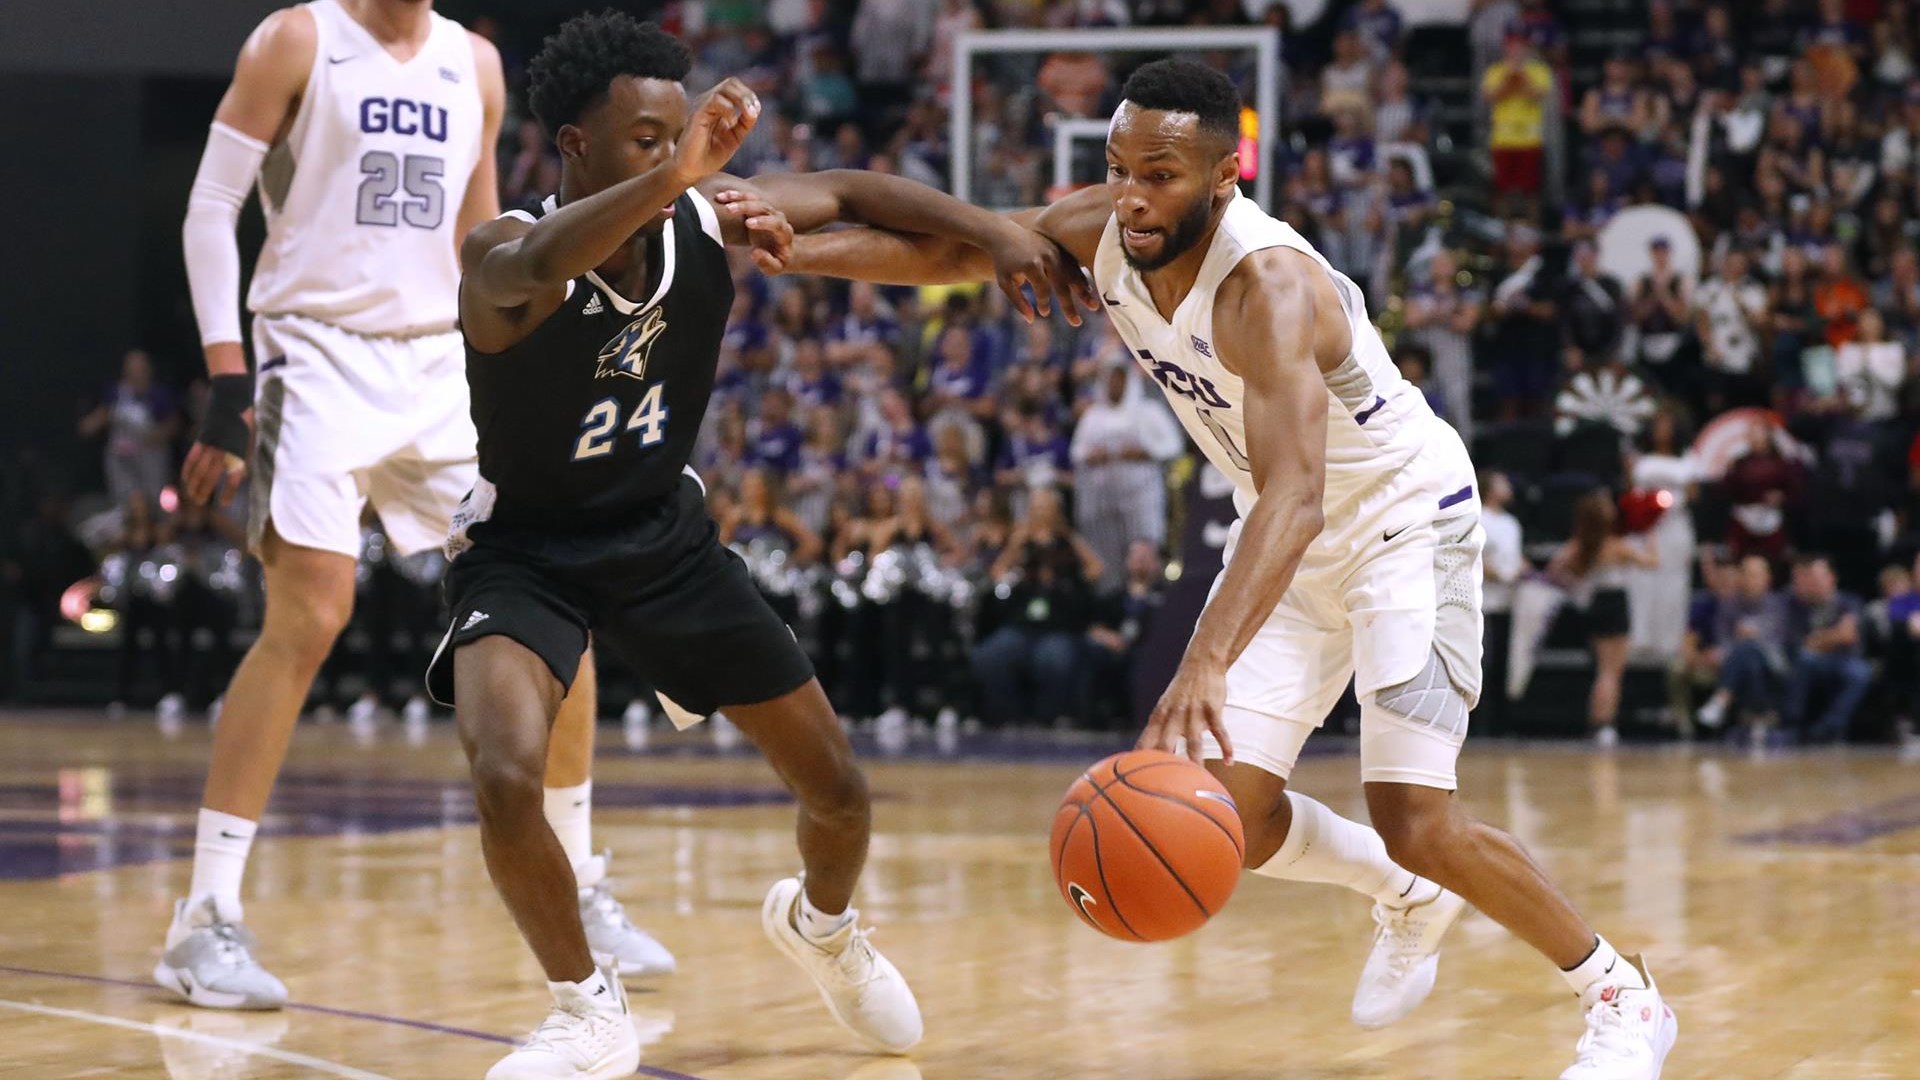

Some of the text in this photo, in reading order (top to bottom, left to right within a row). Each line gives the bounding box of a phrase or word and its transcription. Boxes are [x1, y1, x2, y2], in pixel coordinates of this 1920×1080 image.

[360, 96, 448, 142] GCU
[356, 150, 445, 230] 25
[571, 380, 669, 461] 24
